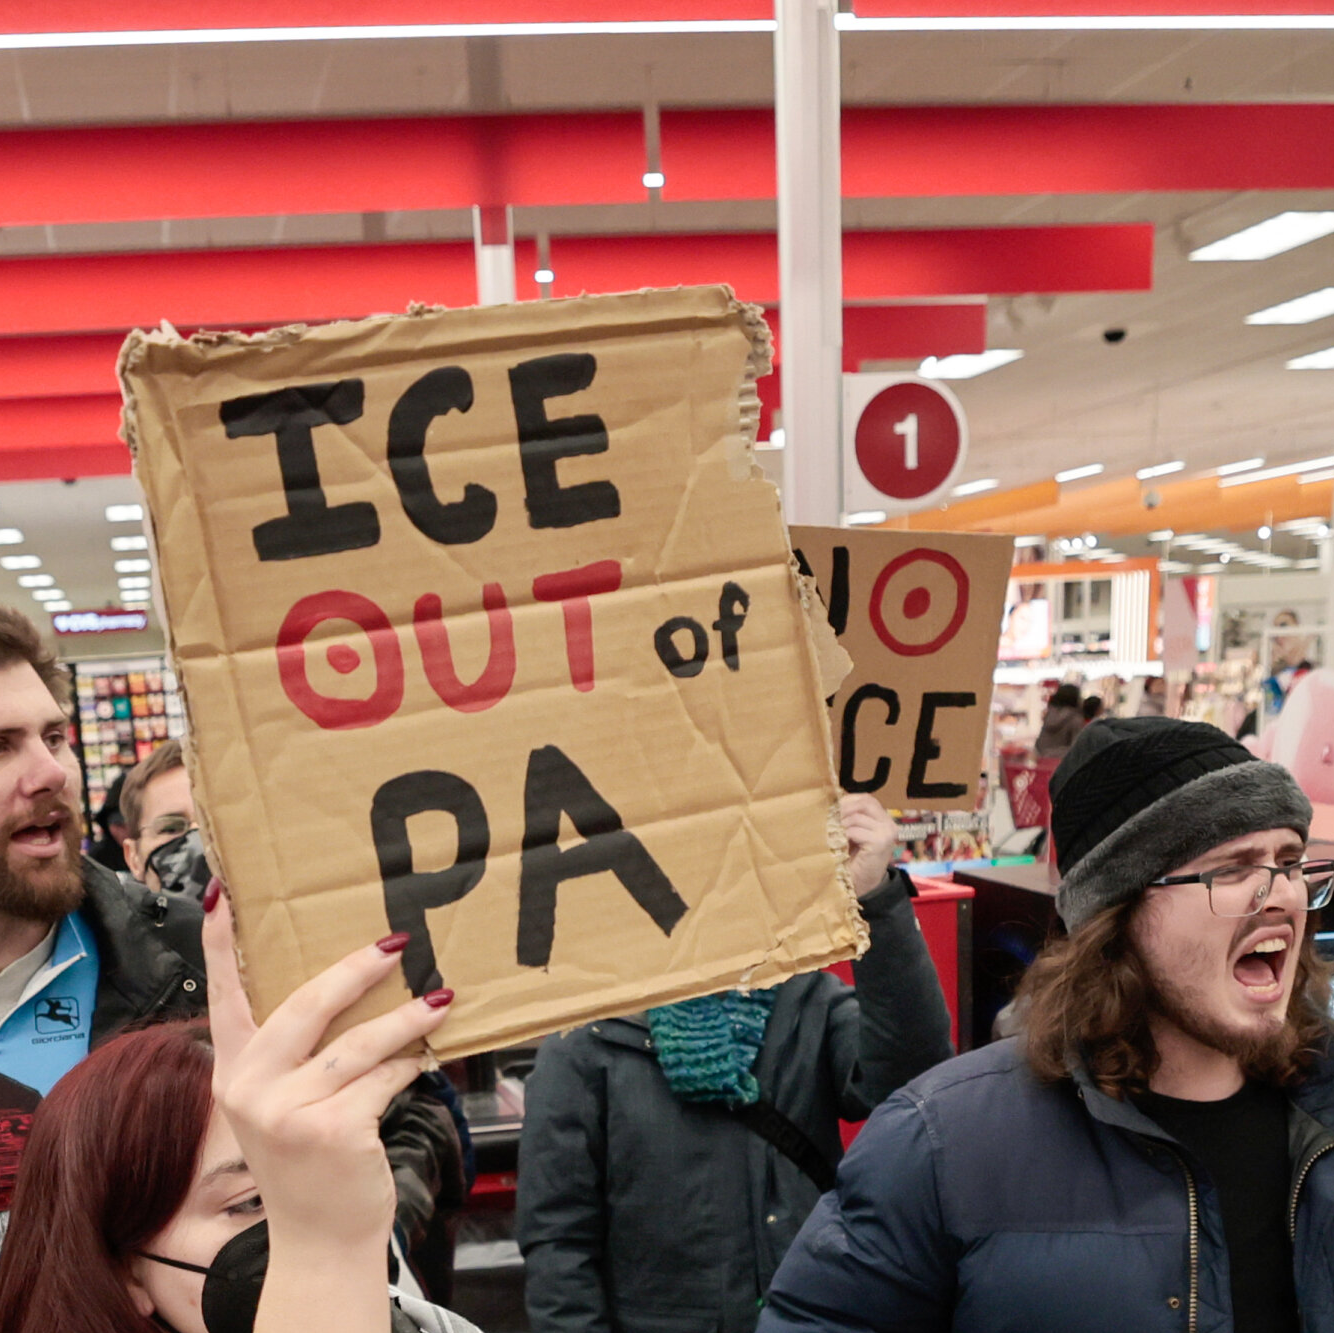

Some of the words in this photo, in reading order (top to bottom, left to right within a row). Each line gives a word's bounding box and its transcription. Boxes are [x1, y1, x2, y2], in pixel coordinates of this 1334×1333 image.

[219, 351, 622, 562] ICE
[893, 412, 918, 470] 1
[276, 559, 622, 731] OUT
[653, 581, 750, 679] of
[827, 683, 977, 800] CE
[369, 744, 691, 1000] PA
